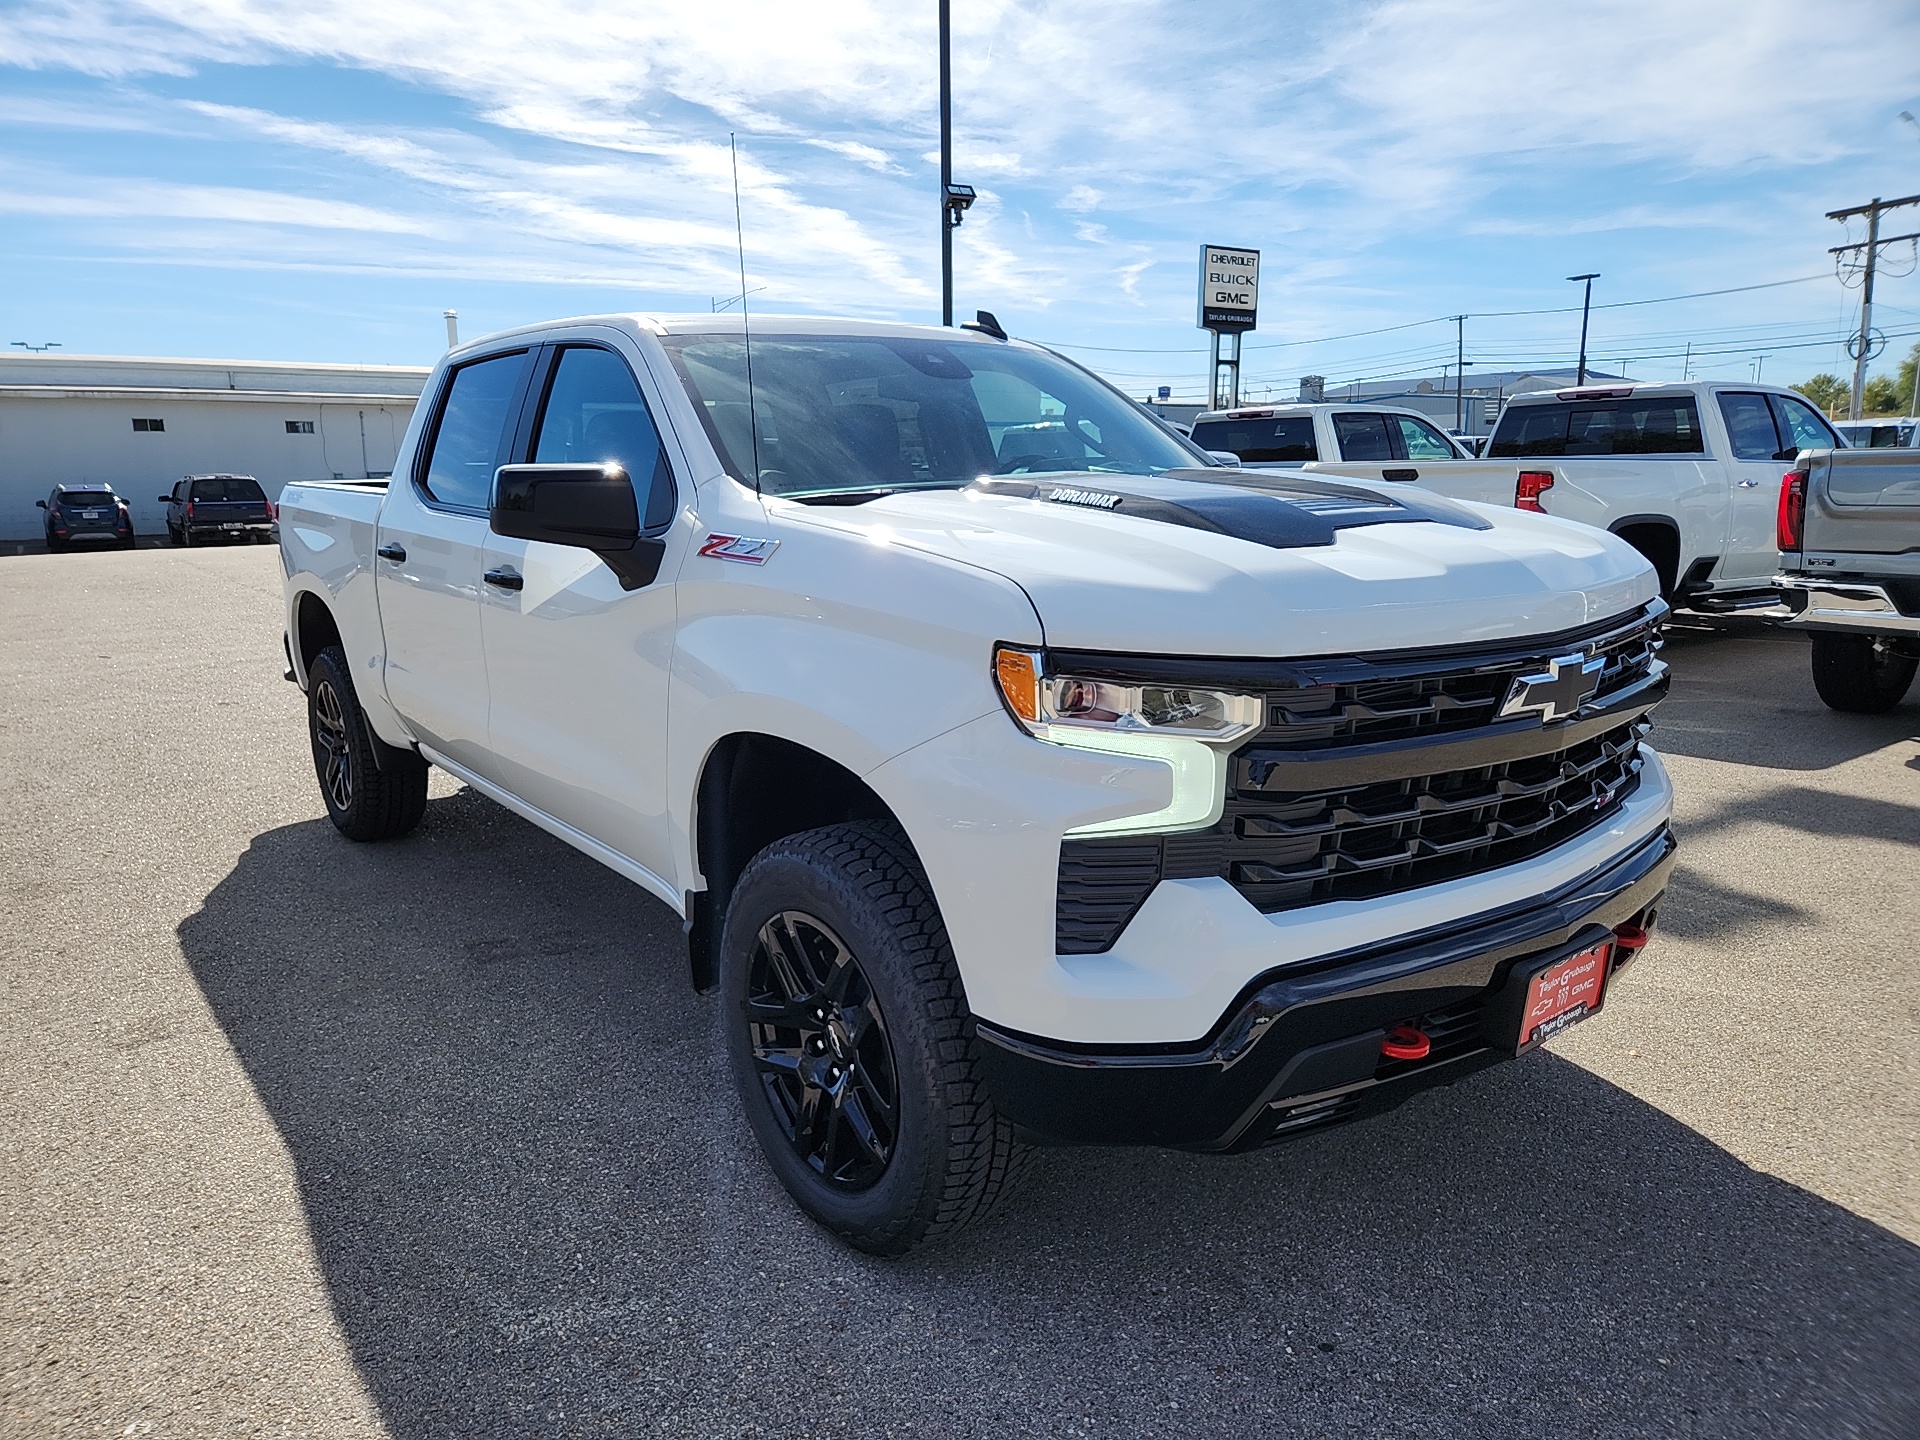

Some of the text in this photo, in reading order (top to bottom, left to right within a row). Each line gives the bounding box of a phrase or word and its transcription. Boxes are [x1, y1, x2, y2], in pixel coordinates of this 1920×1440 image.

[1211, 254, 1256, 267] CHEVROLET
[1210, 273, 1255, 286] BUICK
[1216, 292, 1249, 304] GMC
[1208, 313, 1226, 321] TAYLOR
[696, 532, 780, 566] Z71
[1539, 959, 1596, 998] Taylor Grubaugh
[1572, 978, 1595, 996] GMC
[1539, 1019, 1557, 1038] Taylor
